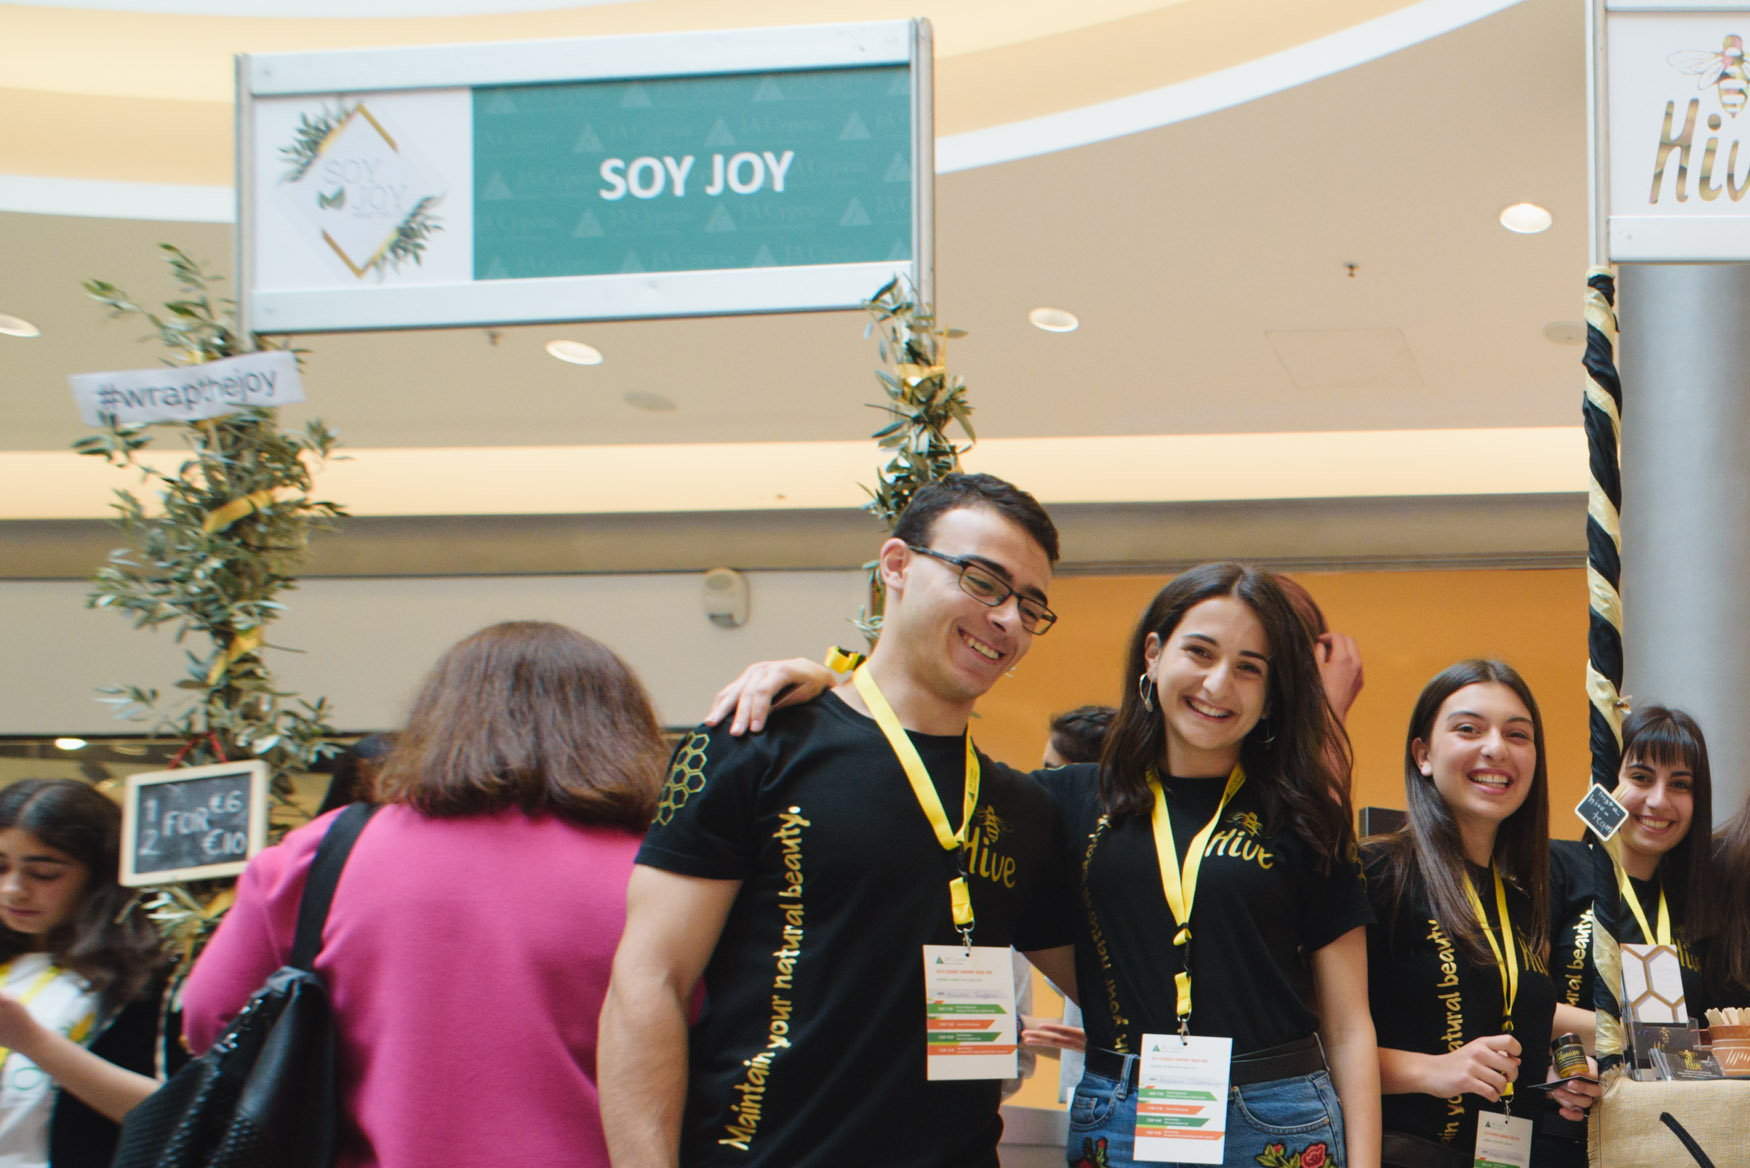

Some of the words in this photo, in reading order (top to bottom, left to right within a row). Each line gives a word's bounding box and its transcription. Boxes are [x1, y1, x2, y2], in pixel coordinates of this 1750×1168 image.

[600, 155, 695, 201] SOY
[705, 150, 795, 196] JOY
[96, 369, 278, 412] #wrapthejoy
[138, 829, 161, 856] 2
[202, 828, 248, 855] €10
[144, 799, 158, 822] 1
[162, 807, 210, 837] FOR
[209, 790, 243, 814] €6
[772, 806, 811, 897] beauty.
[964, 824, 1016, 888] Hive
[773, 903, 804, 990] natural
[767, 994, 792, 1050] your
[1438, 991, 1463, 1053] atural
[718, 1051, 776, 1151] Maintain
